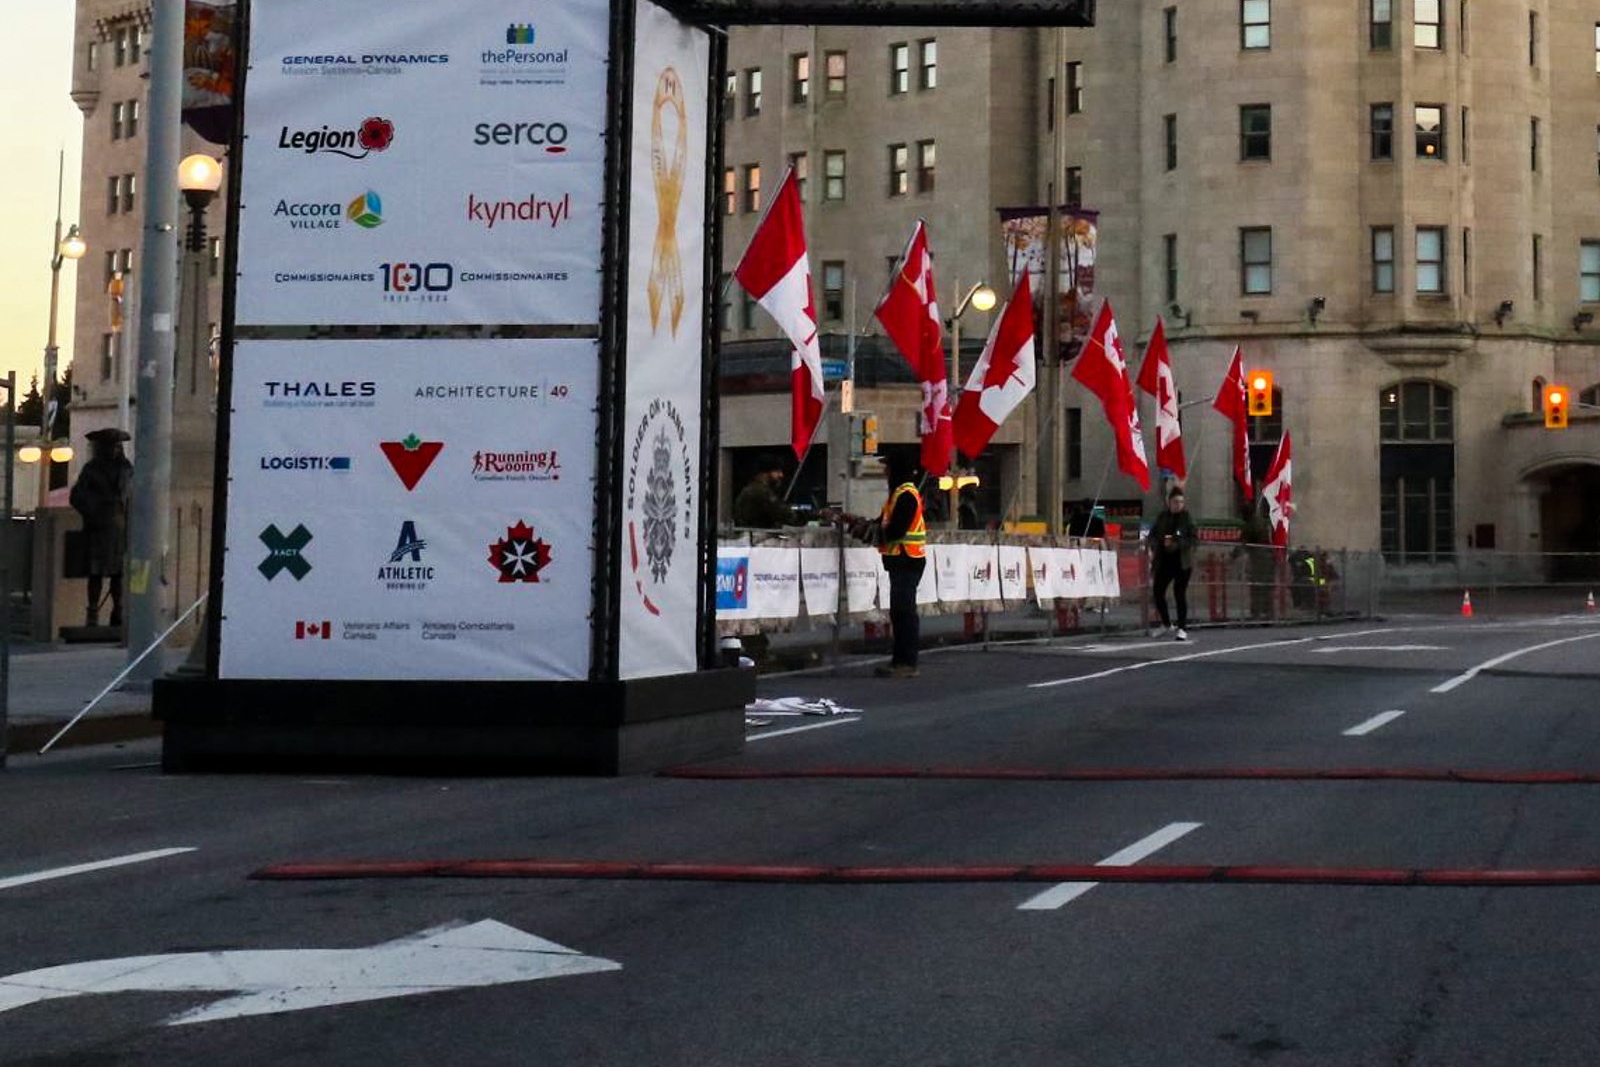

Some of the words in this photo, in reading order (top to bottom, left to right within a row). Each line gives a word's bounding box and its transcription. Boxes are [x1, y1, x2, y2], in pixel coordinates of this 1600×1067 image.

[282, 55, 357, 65] GENERAL
[362, 54, 449, 65] DYNAMICS
[278, 125, 356, 154] Legion
[474, 122, 568, 146] serco
[273, 199, 341, 216] Accora
[468, 193, 569, 229] kyndryl
[290, 220, 341, 229] VILLAGE
[264, 382, 376, 397] THALES
[415, 386, 538, 398] ARCHITECTURE
[550, 386, 568, 397] 49
[485, 450, 547, 472] Running
[378, 567, 434, 580] ATHLETIC
